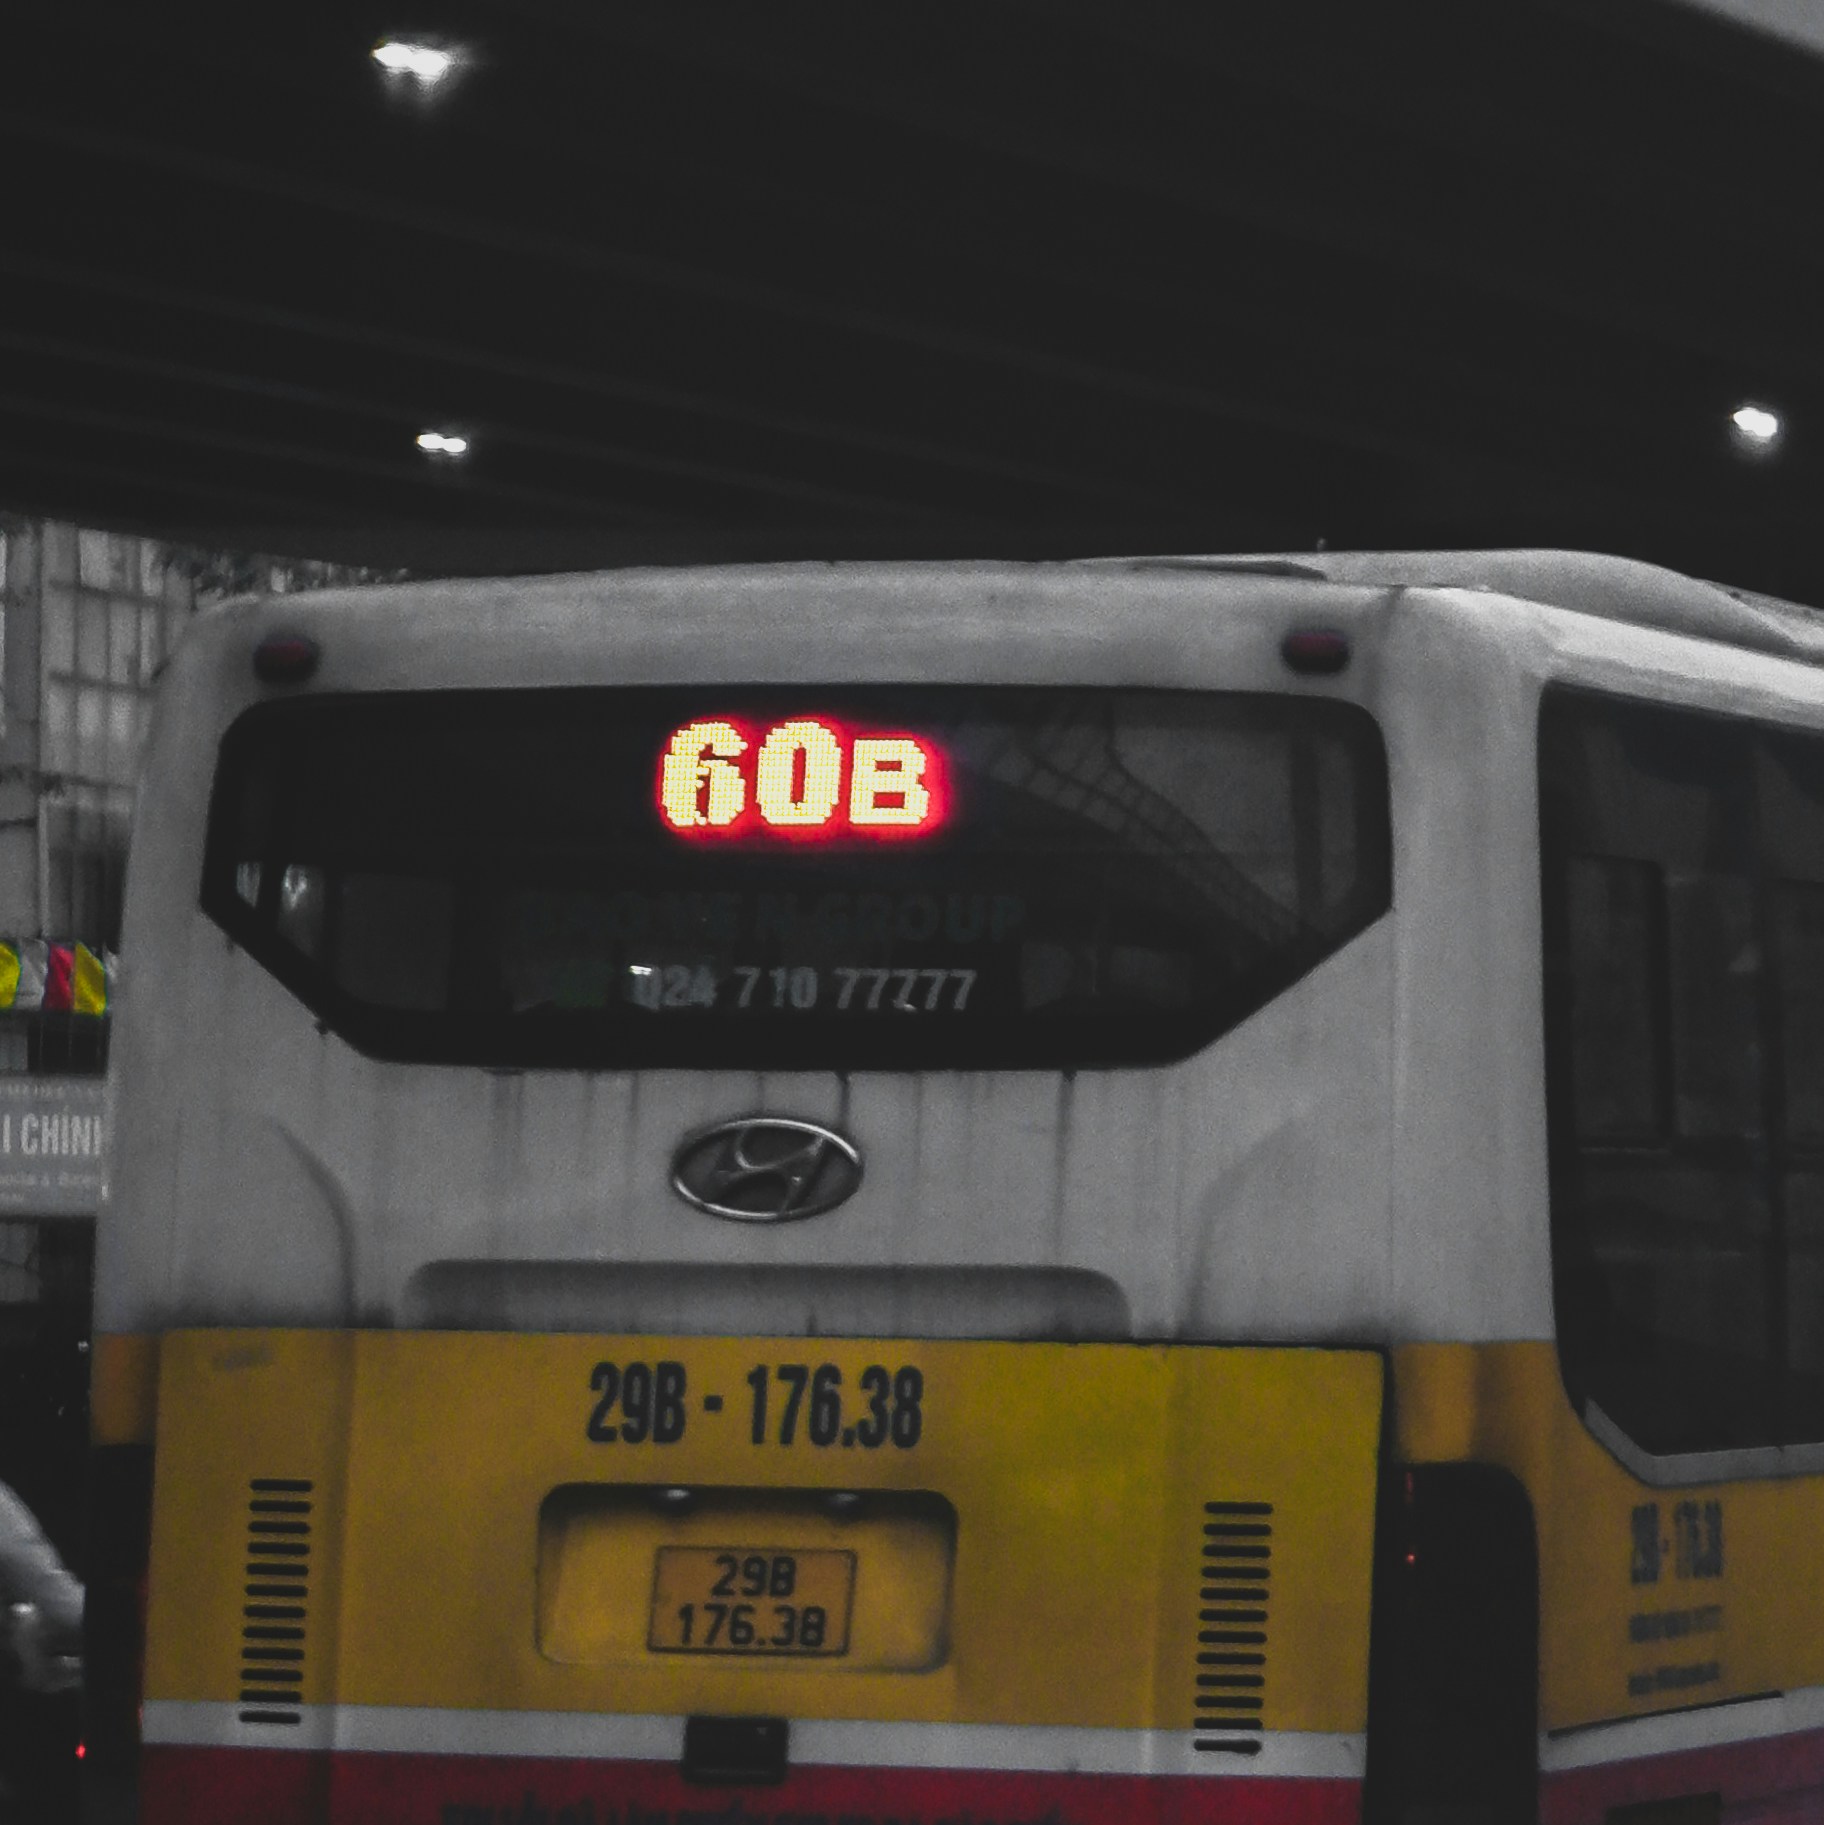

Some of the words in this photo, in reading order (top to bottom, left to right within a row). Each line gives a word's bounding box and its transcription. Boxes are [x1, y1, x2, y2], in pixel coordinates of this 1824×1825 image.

[662, 721, 932, 826] 60B
[587, 1361, 687, 1444] 29B
[747, 1363, 925, 1449] 176.38
[709, 1555, 797, 1598] 29B
[677, 1603, 826, 1648] 176.38
